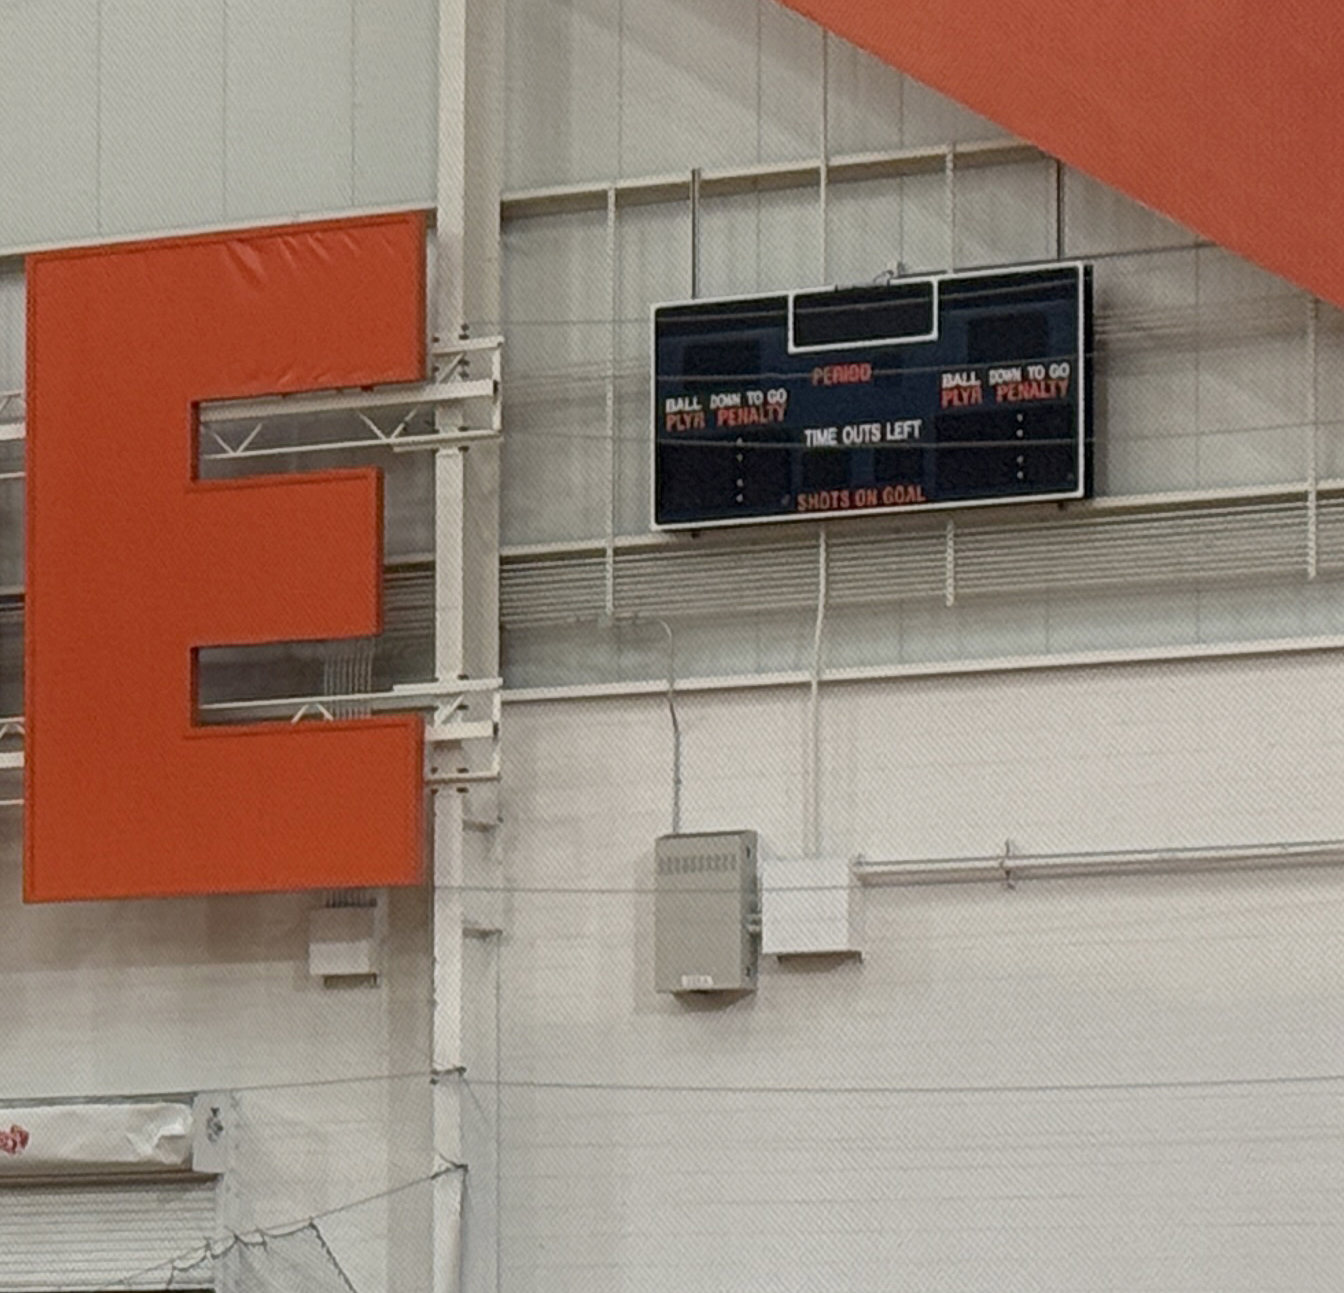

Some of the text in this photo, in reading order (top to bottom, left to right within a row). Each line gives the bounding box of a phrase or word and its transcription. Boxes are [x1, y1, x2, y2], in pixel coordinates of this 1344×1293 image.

[812, 363, 872, 386] PERIOD
[942, 362, 1070, 388] BALL DOWN TO GO
[665, 388, 787, 413] BALL DOWN TO GO
[942, 378, 1069, 409] PLYR PENALTY
[666, 404, 787, 432] PLYR PENALTY
[804, 419, 922, 447] TIME OUTS LEFT
[797, 485, 926, 511] SHOTS ON GOAL
